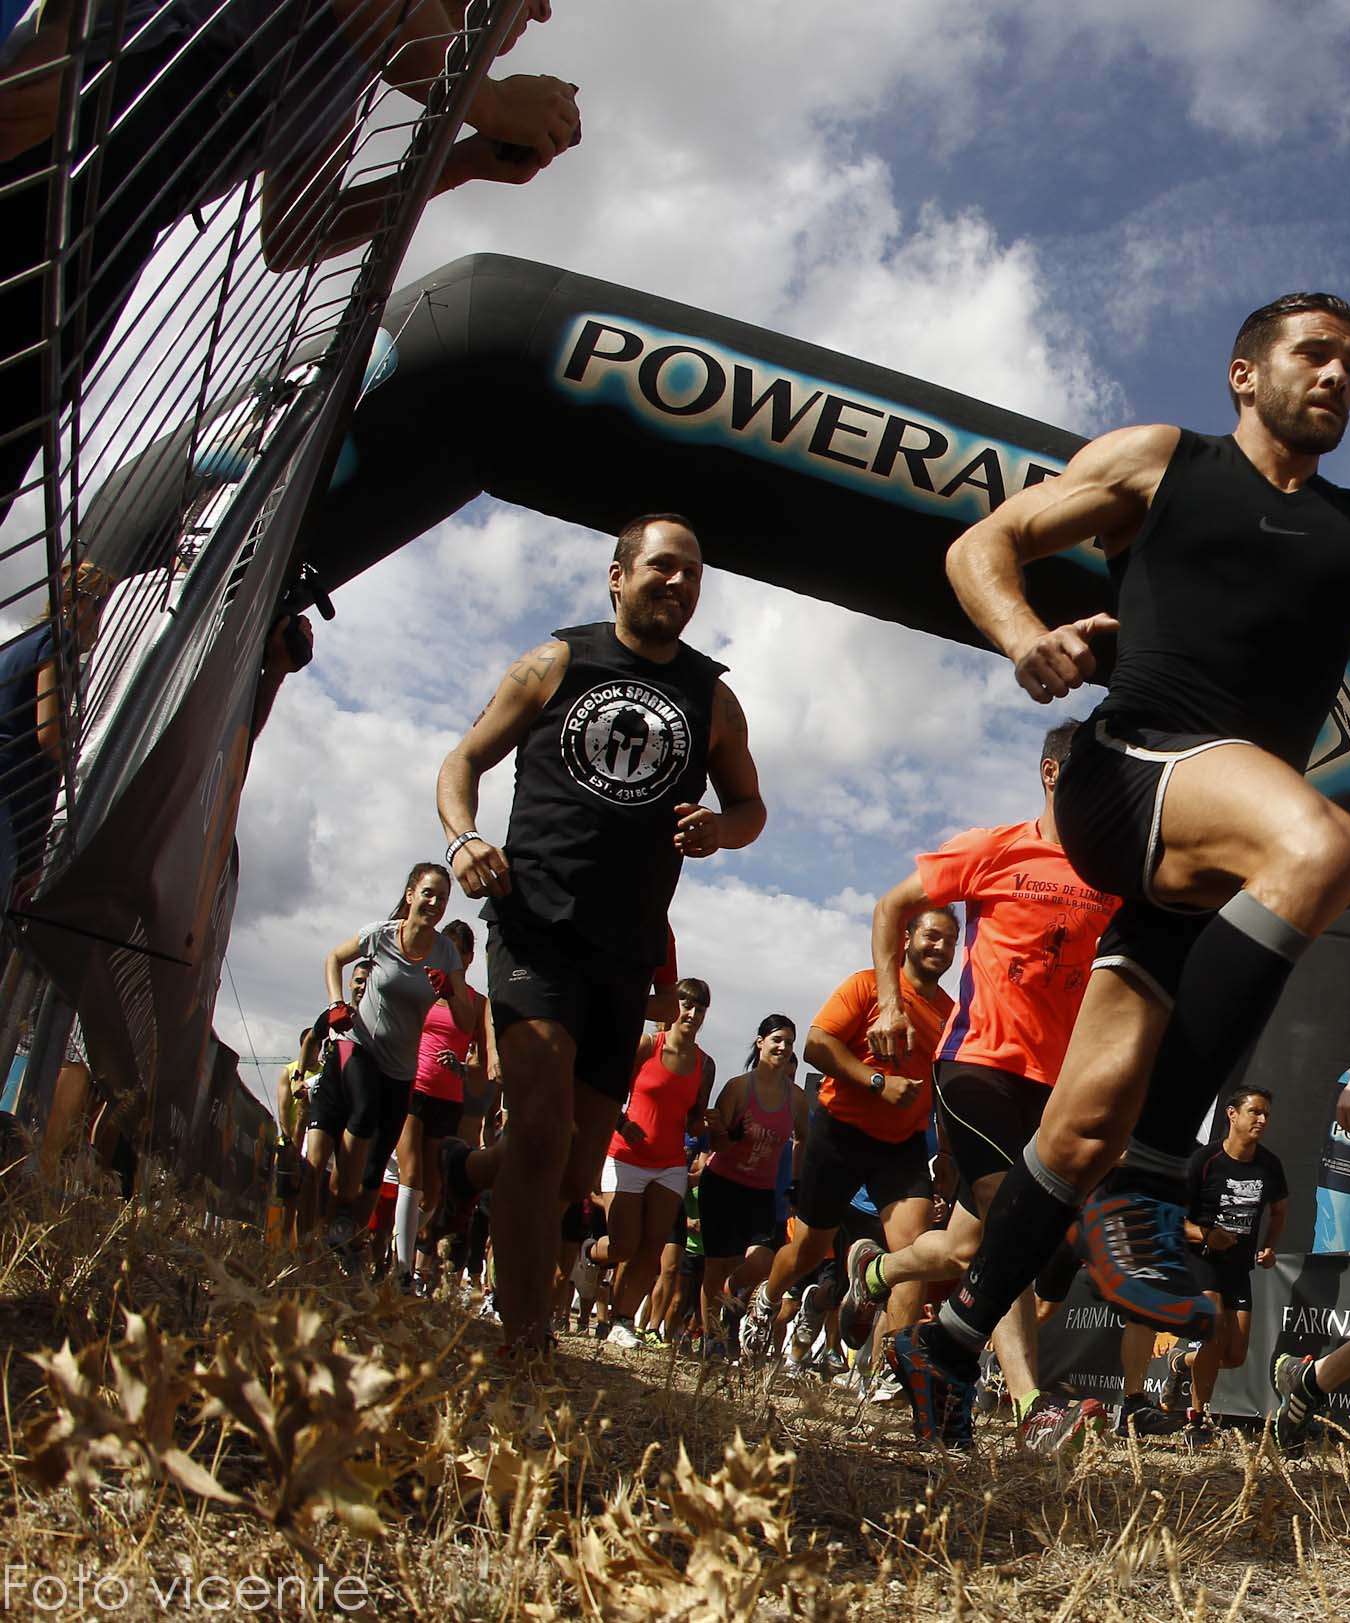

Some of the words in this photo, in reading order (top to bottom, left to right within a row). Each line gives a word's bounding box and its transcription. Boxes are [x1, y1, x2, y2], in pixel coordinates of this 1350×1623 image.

[568, 685, 624, 732] Reebok
[625, 686, 678, 722] SPARTAN
[670, 720, 687, 758] RACE
[588, 775, 613, 793] EST.
[1026, 880, 1059, 893] CROSS
[1062, 884, 1078, 897] DE
